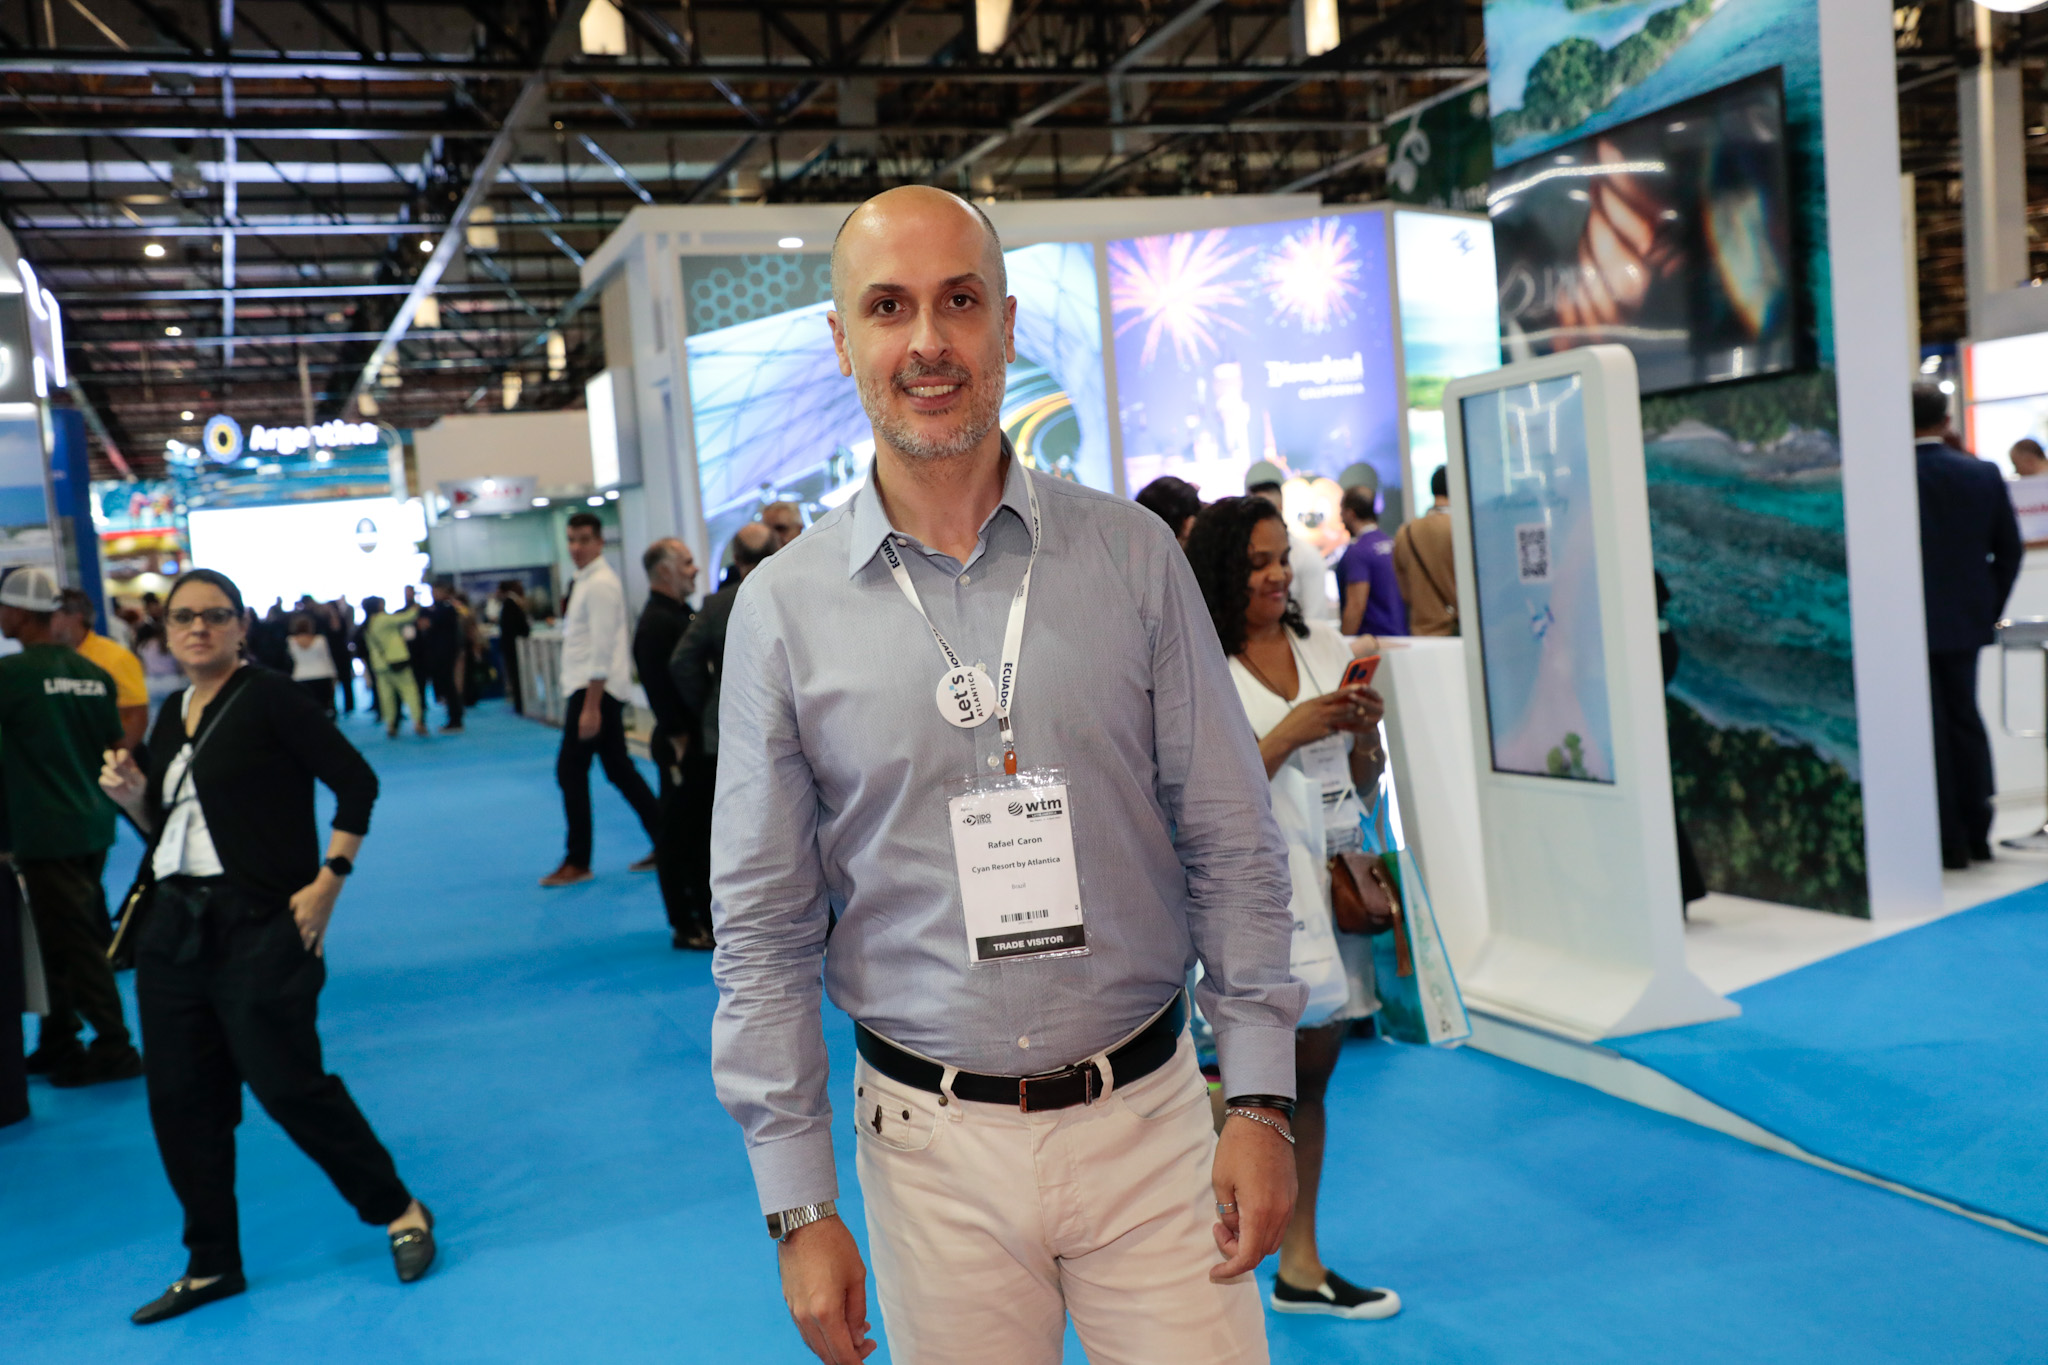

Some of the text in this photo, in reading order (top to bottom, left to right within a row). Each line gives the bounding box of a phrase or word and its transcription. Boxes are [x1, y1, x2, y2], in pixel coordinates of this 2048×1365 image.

[967, 671, 984, 717] ATLANTICA
[1000, 662, 1013, 711] ECUADO
[1025, 798, 1062, 812] wtm
[988, 836, 1043, 849] Rafael Caron
[971, 856, 1061, 874] Cyan Resort by Atlantica
[1011, 882, 1027, 890] Brazil
[993, 935, 1064, 951] TRADE VISITOR
